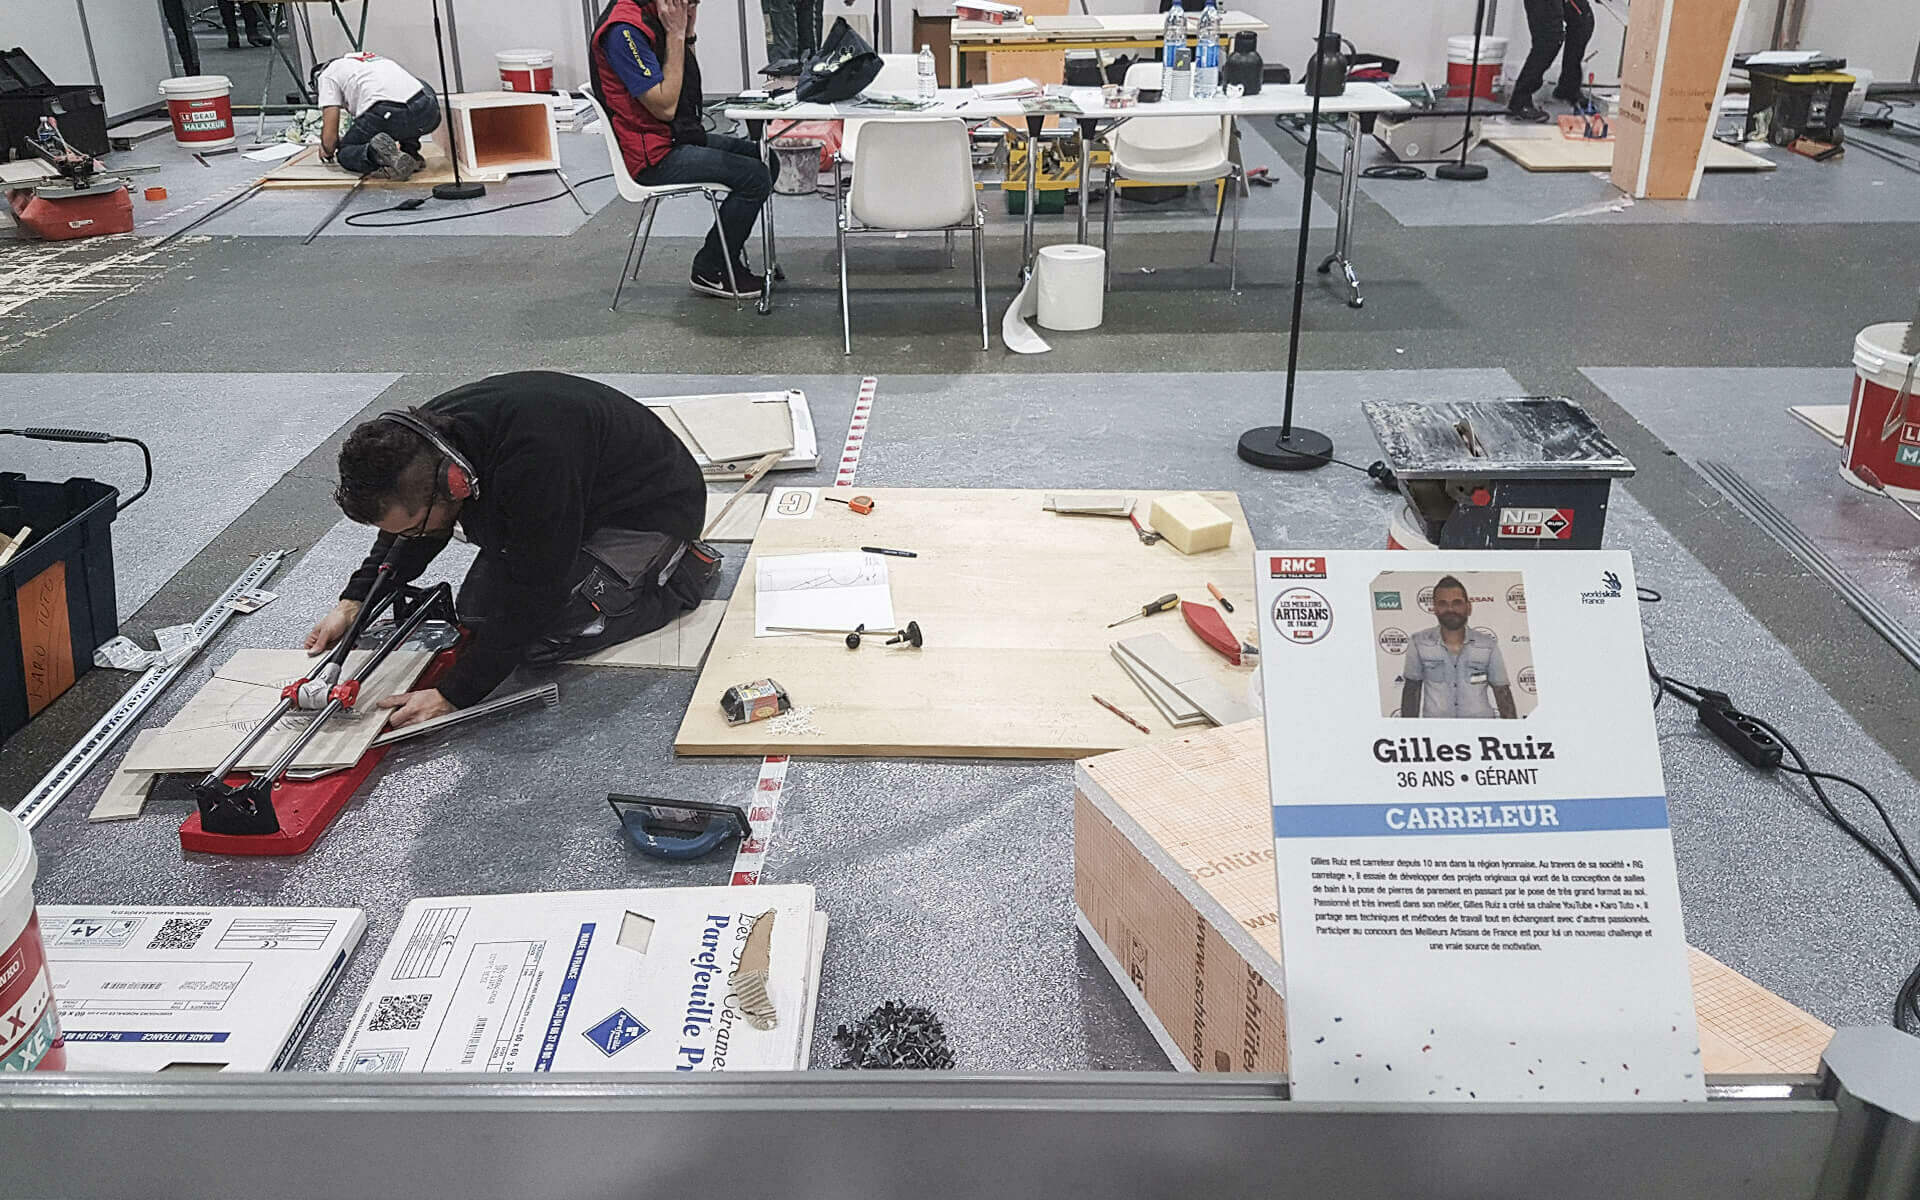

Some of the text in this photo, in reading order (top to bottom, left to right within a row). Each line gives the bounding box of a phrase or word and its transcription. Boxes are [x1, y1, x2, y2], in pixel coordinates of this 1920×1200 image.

[1281, 558, 1316, 572] RMC
[1276, 608, 1328, 620] ARTISANS
[1372, 735, 1556, 764] Gilles Ruiz
[1397, 767, 1539, 788] 36 ANS GÉRANT
[1385, 803, 1560, 830] CARRELEUR
[1186, 849, 1276, 880] Schlüte
[70, 925, 103, 937] A+
[578, 933, 591, 949] MADE
[567, 957, 583, 979] FRANCE
[682, 913, 731, 1037] Parefeuille
[141, 1033, 175, 1041] FRANCE
[178, 1033, 186, 1041] IN
[187, 1033, 213, 1041] MADE
[514, 1033, 525, 1042] 60
[510, 1048, 519, 1057] 60
